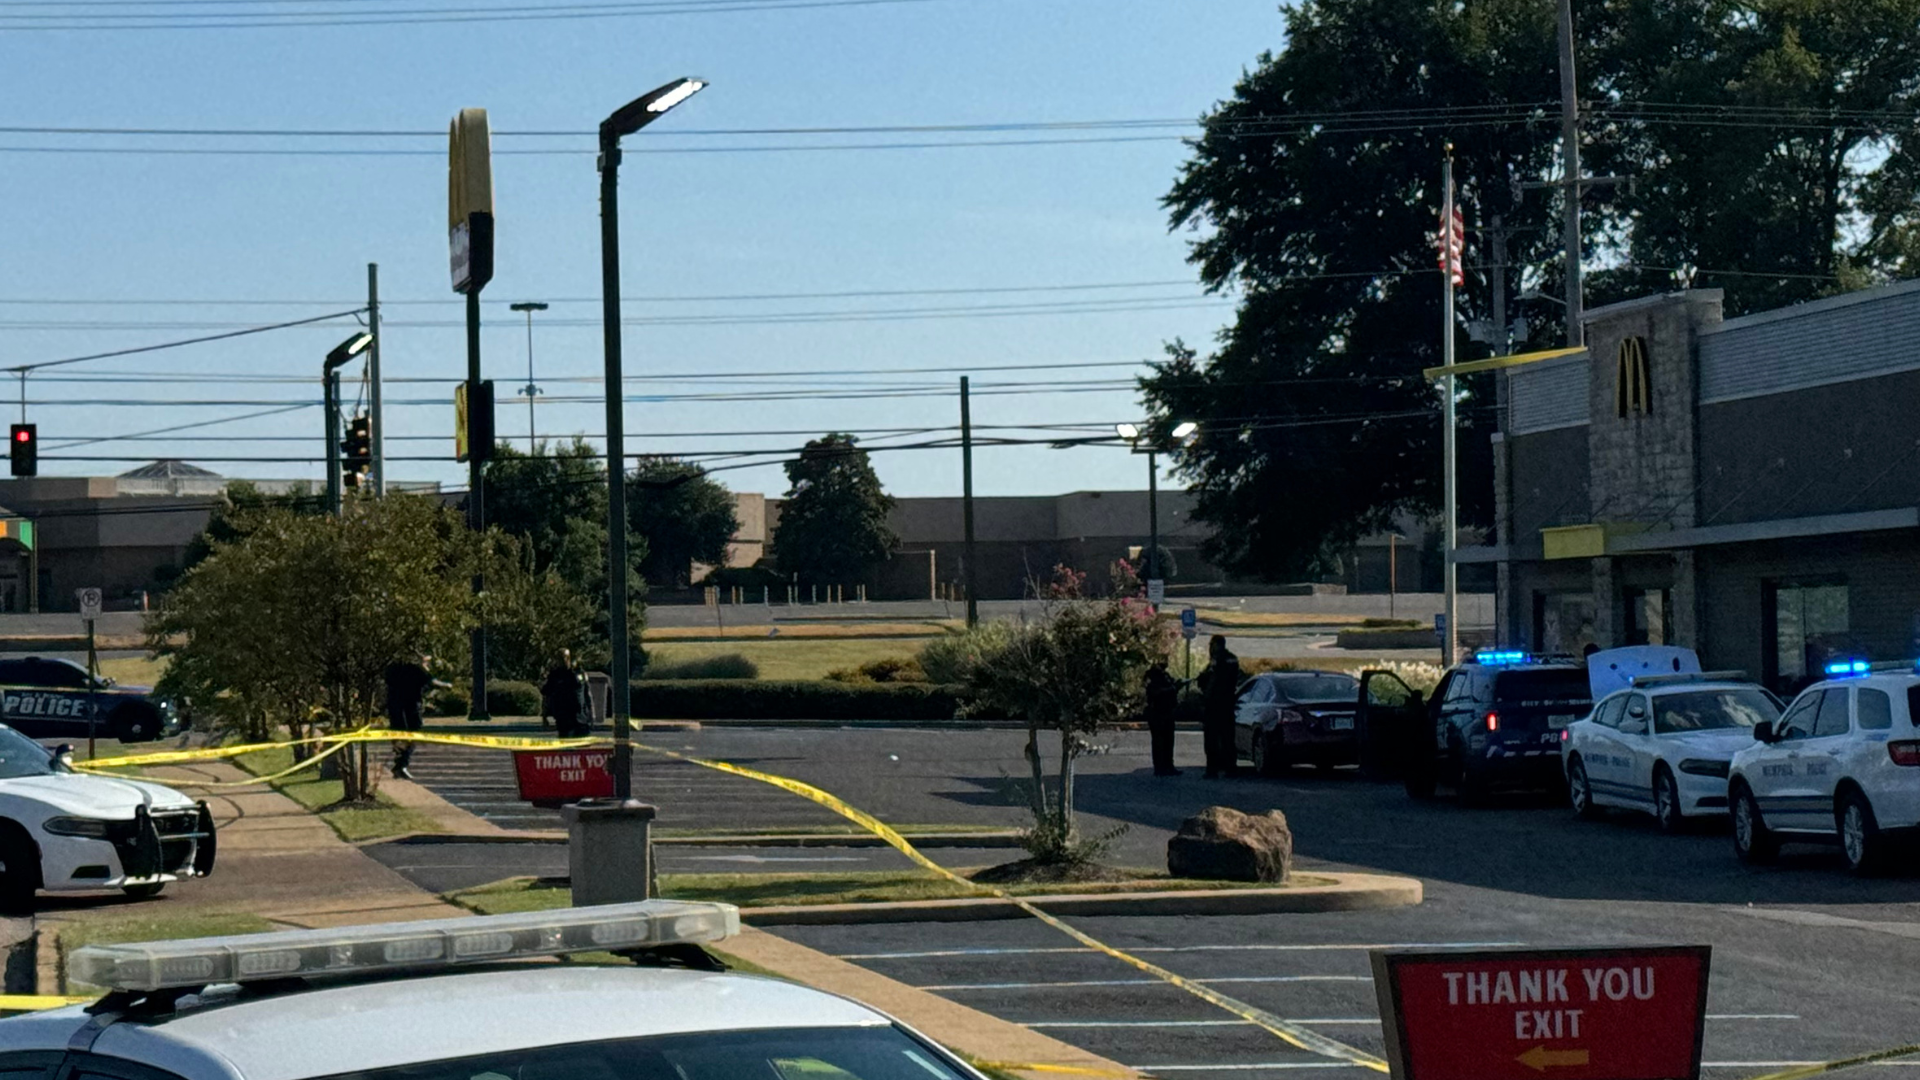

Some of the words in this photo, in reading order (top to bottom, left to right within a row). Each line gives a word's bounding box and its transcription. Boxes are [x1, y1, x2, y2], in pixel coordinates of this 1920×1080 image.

[3, 695, 86, 716] POLICE
[1540, 732, 1561, 744] PO
[534, 755, 581, 769] THANK
[560, 769, 587, 782] EXIT
[1442, 968, 1569, 1005] THANK
[1582, 966, 1655, 1001] YOU
[1515, 1009, 1584, 1040] EXIT
